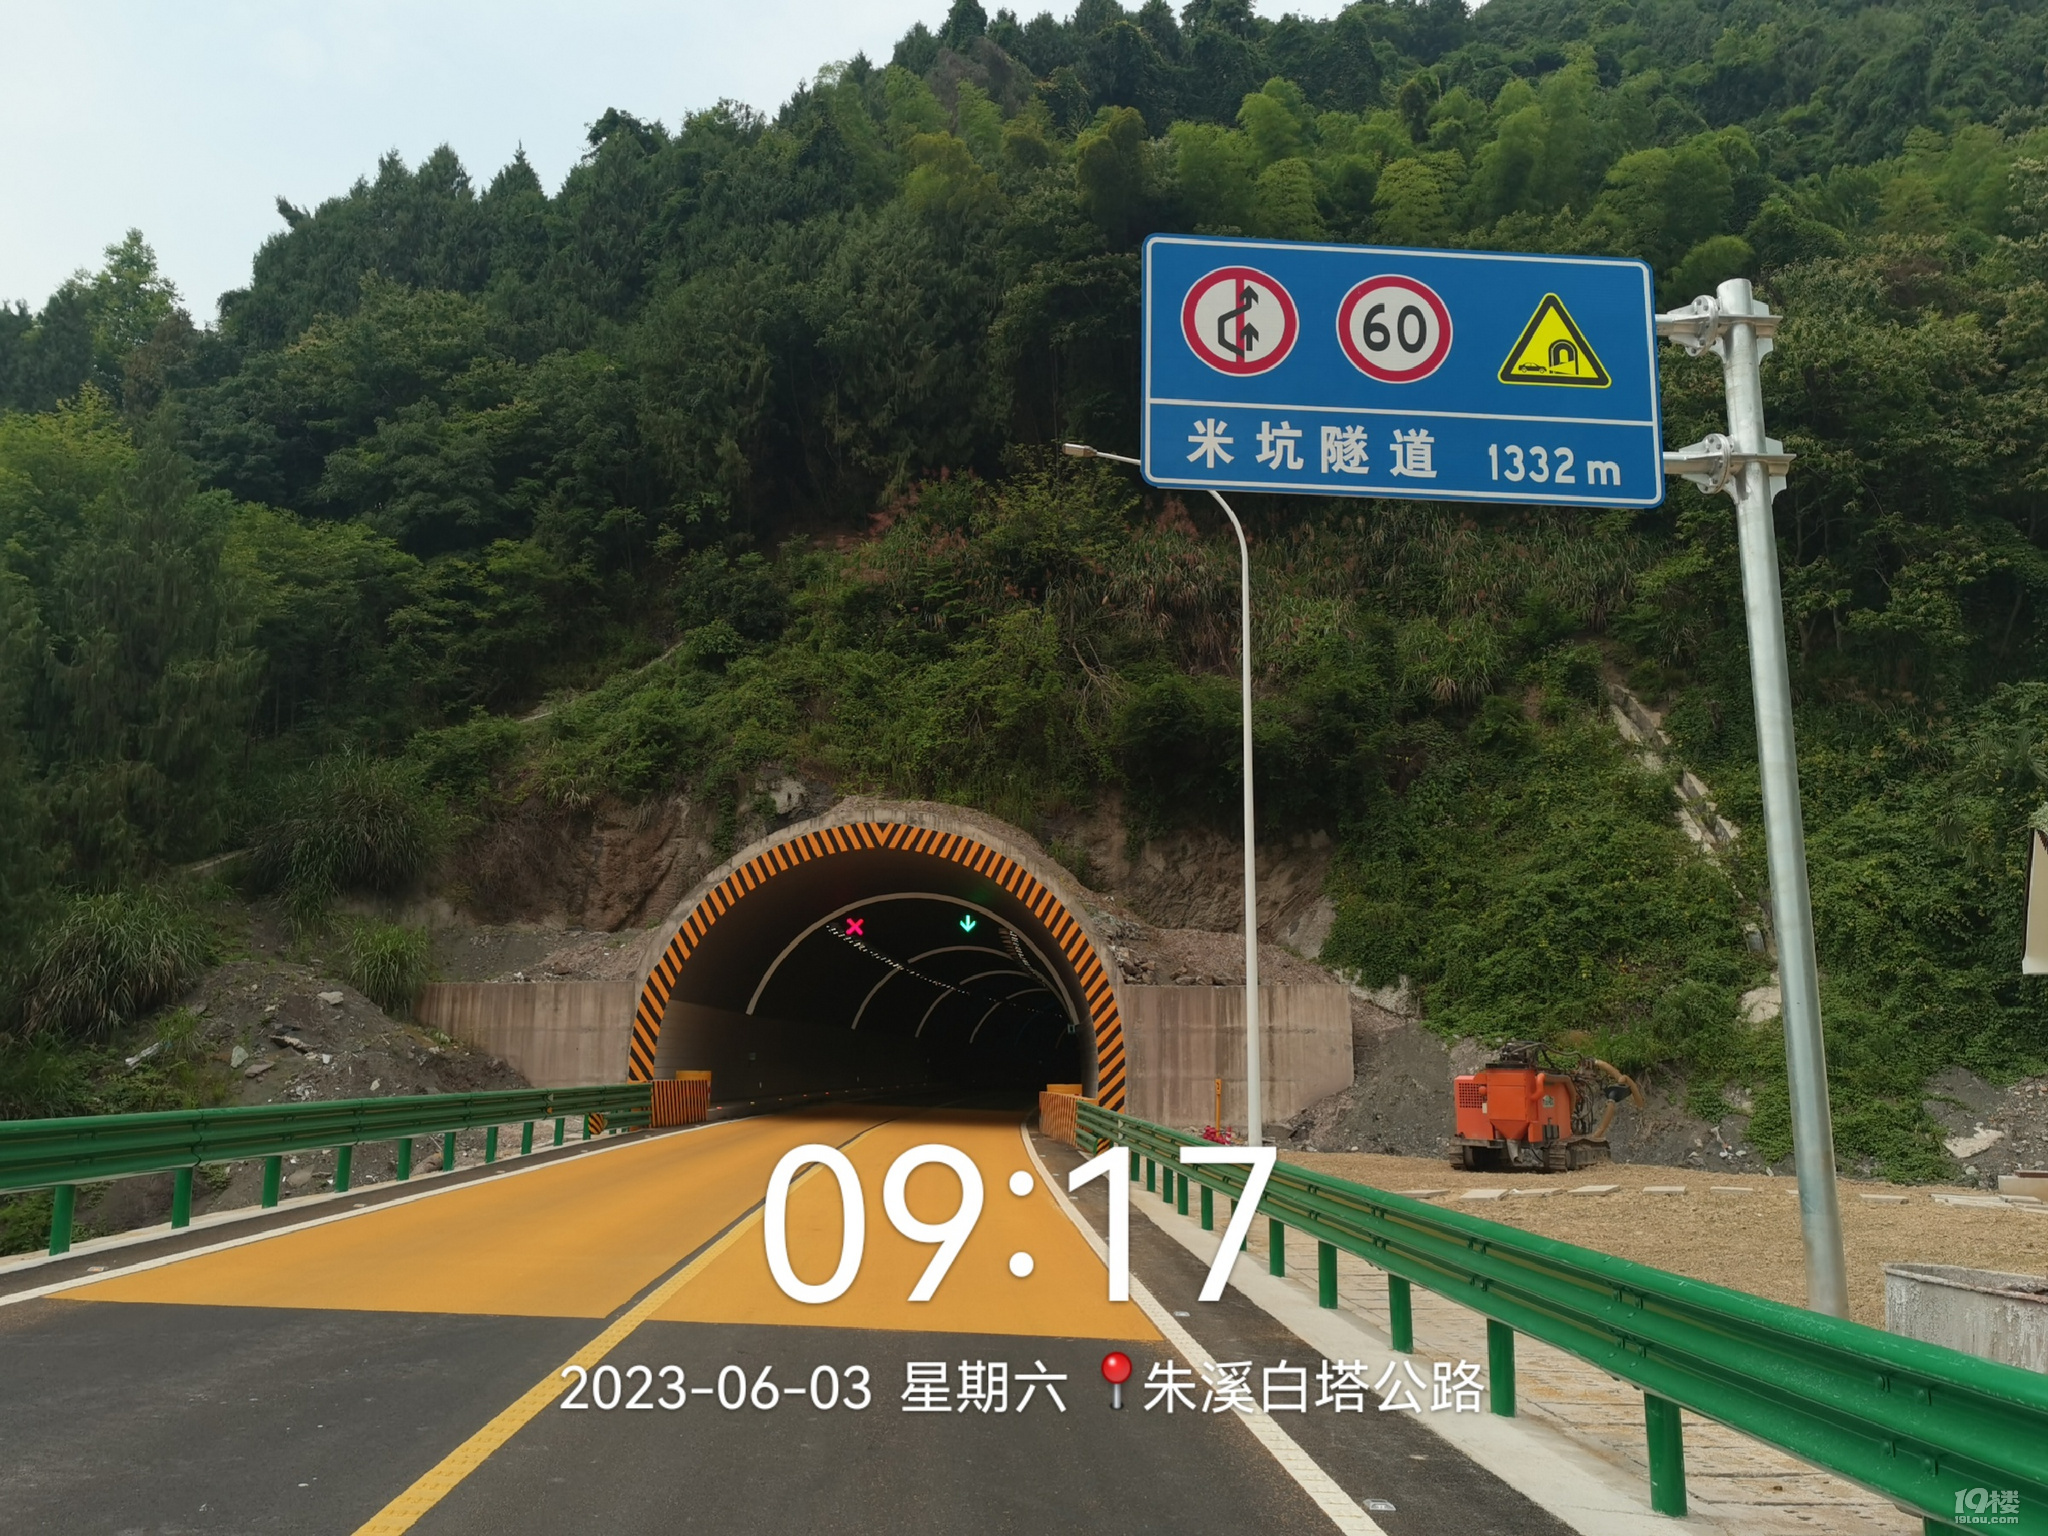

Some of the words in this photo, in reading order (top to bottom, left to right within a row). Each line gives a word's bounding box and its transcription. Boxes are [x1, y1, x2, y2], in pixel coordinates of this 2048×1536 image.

[1363, 303, 1427, 354] 60
[1187, 418, 1438, 479] 米坑隧道
